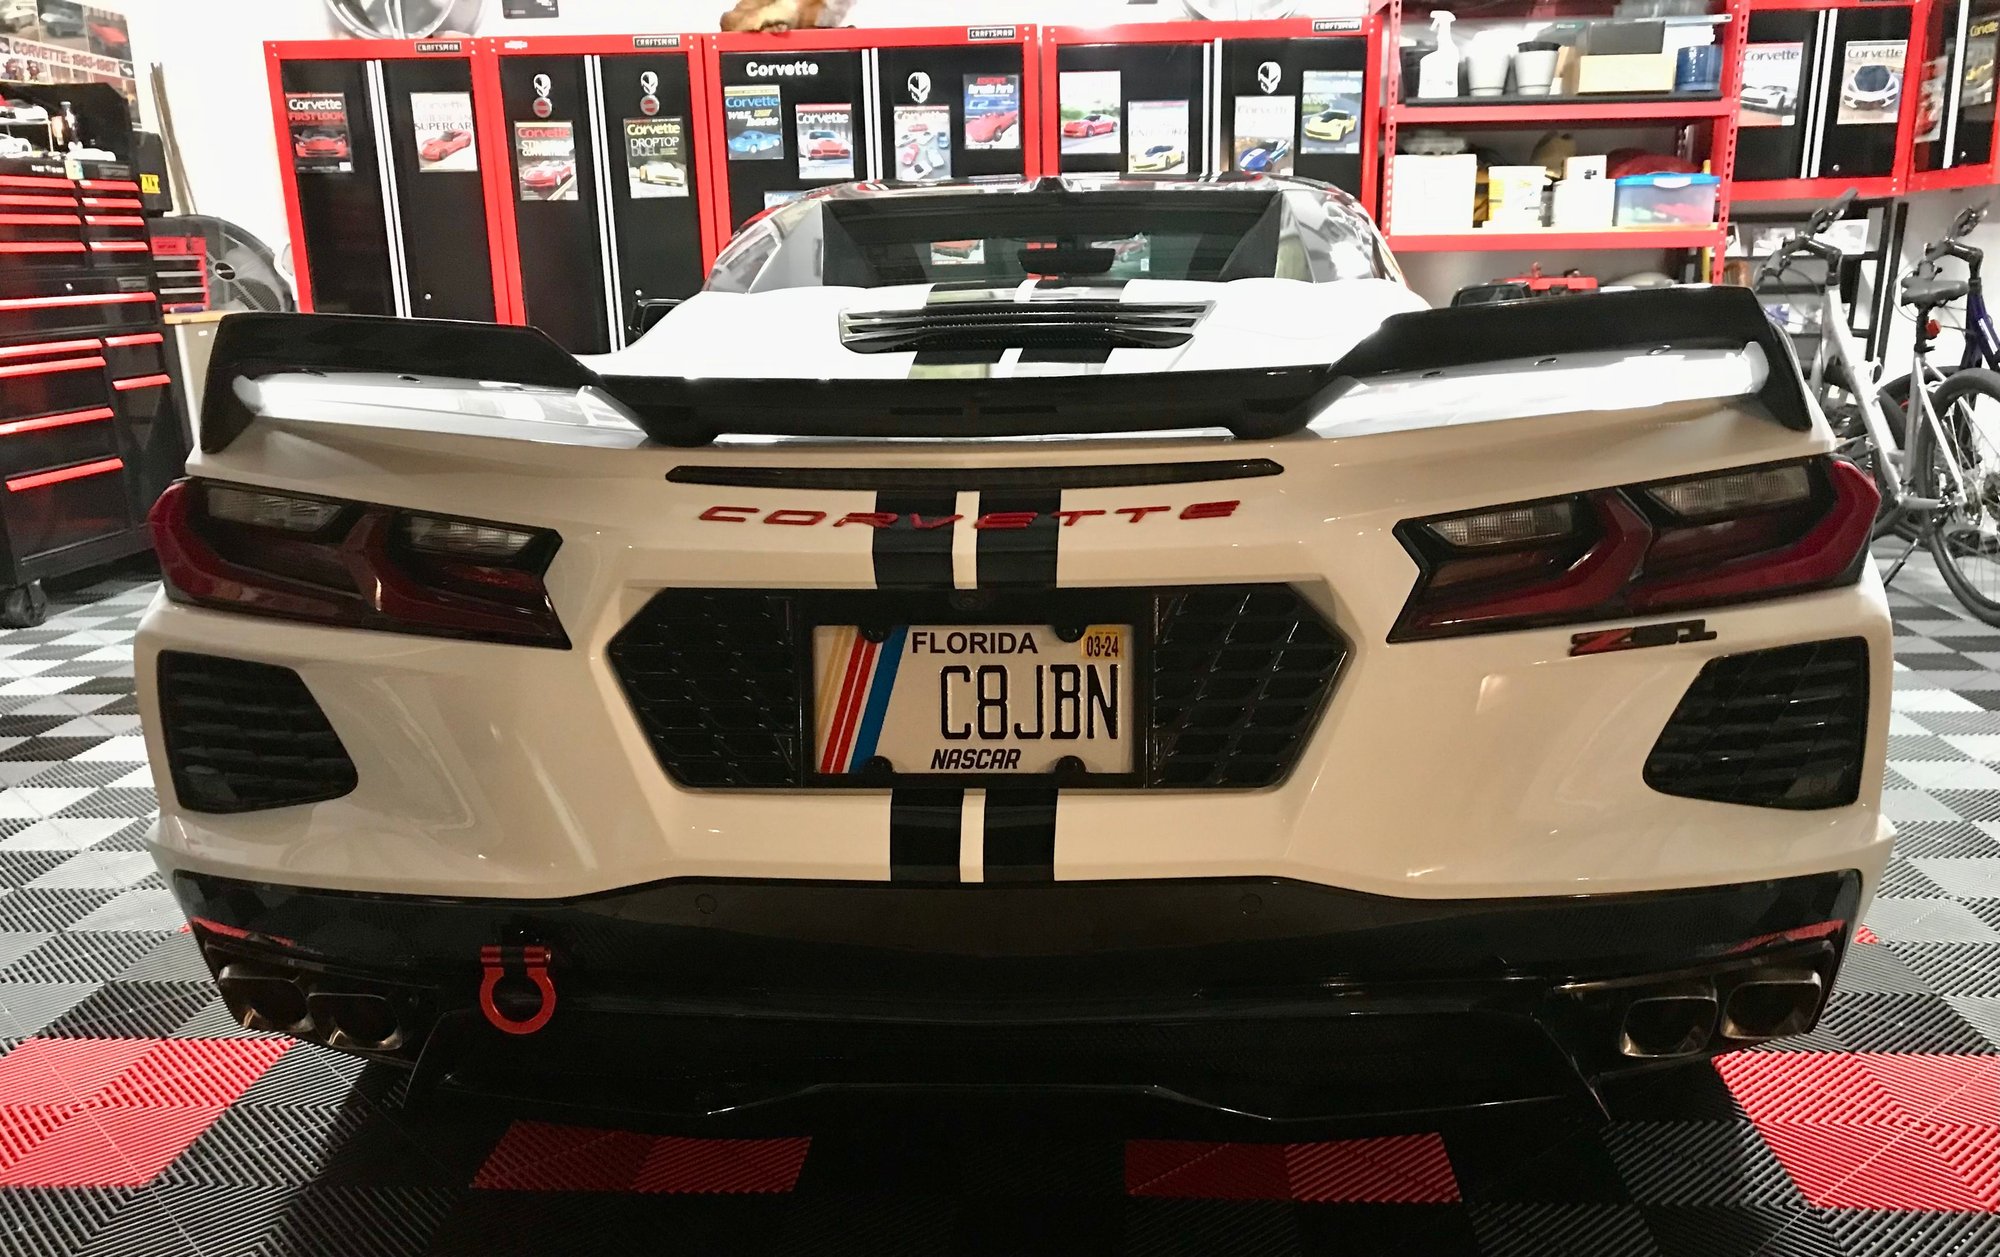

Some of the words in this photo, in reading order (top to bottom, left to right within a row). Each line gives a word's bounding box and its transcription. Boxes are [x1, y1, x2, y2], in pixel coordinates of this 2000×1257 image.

[417, 43, 459, 51] CRAFTSMAN
[636, 37, 678, 46] CRAFTSMAN
[1848, 48, 1903, 59] Corvette
[746, 61, 818, 76] Corvette
[289, 99, 342, 110] Corvette
[725, 96, 779, 108] Corvette
[797, 112, 849, 124] Corvette
[415, 121, 471, 132] SUPERCAR
[627, 124, 680, 136] Corvette
[518, 127, 571, 139] Corvette
[631, 137, 680, 148] DROPTOP
[631, 147, 659, 157] DUEL
[698, 499, 1242, 529] CORVETTE
[912, 632, 1038, 654] FLORIDA
[1568, 619, 1717, 656] Z51
[1086, 635, 1119, 658] 03-24
[940, 664, 1119, 740] C8JBN
[930, 748, 1021, 770] NASCAR
